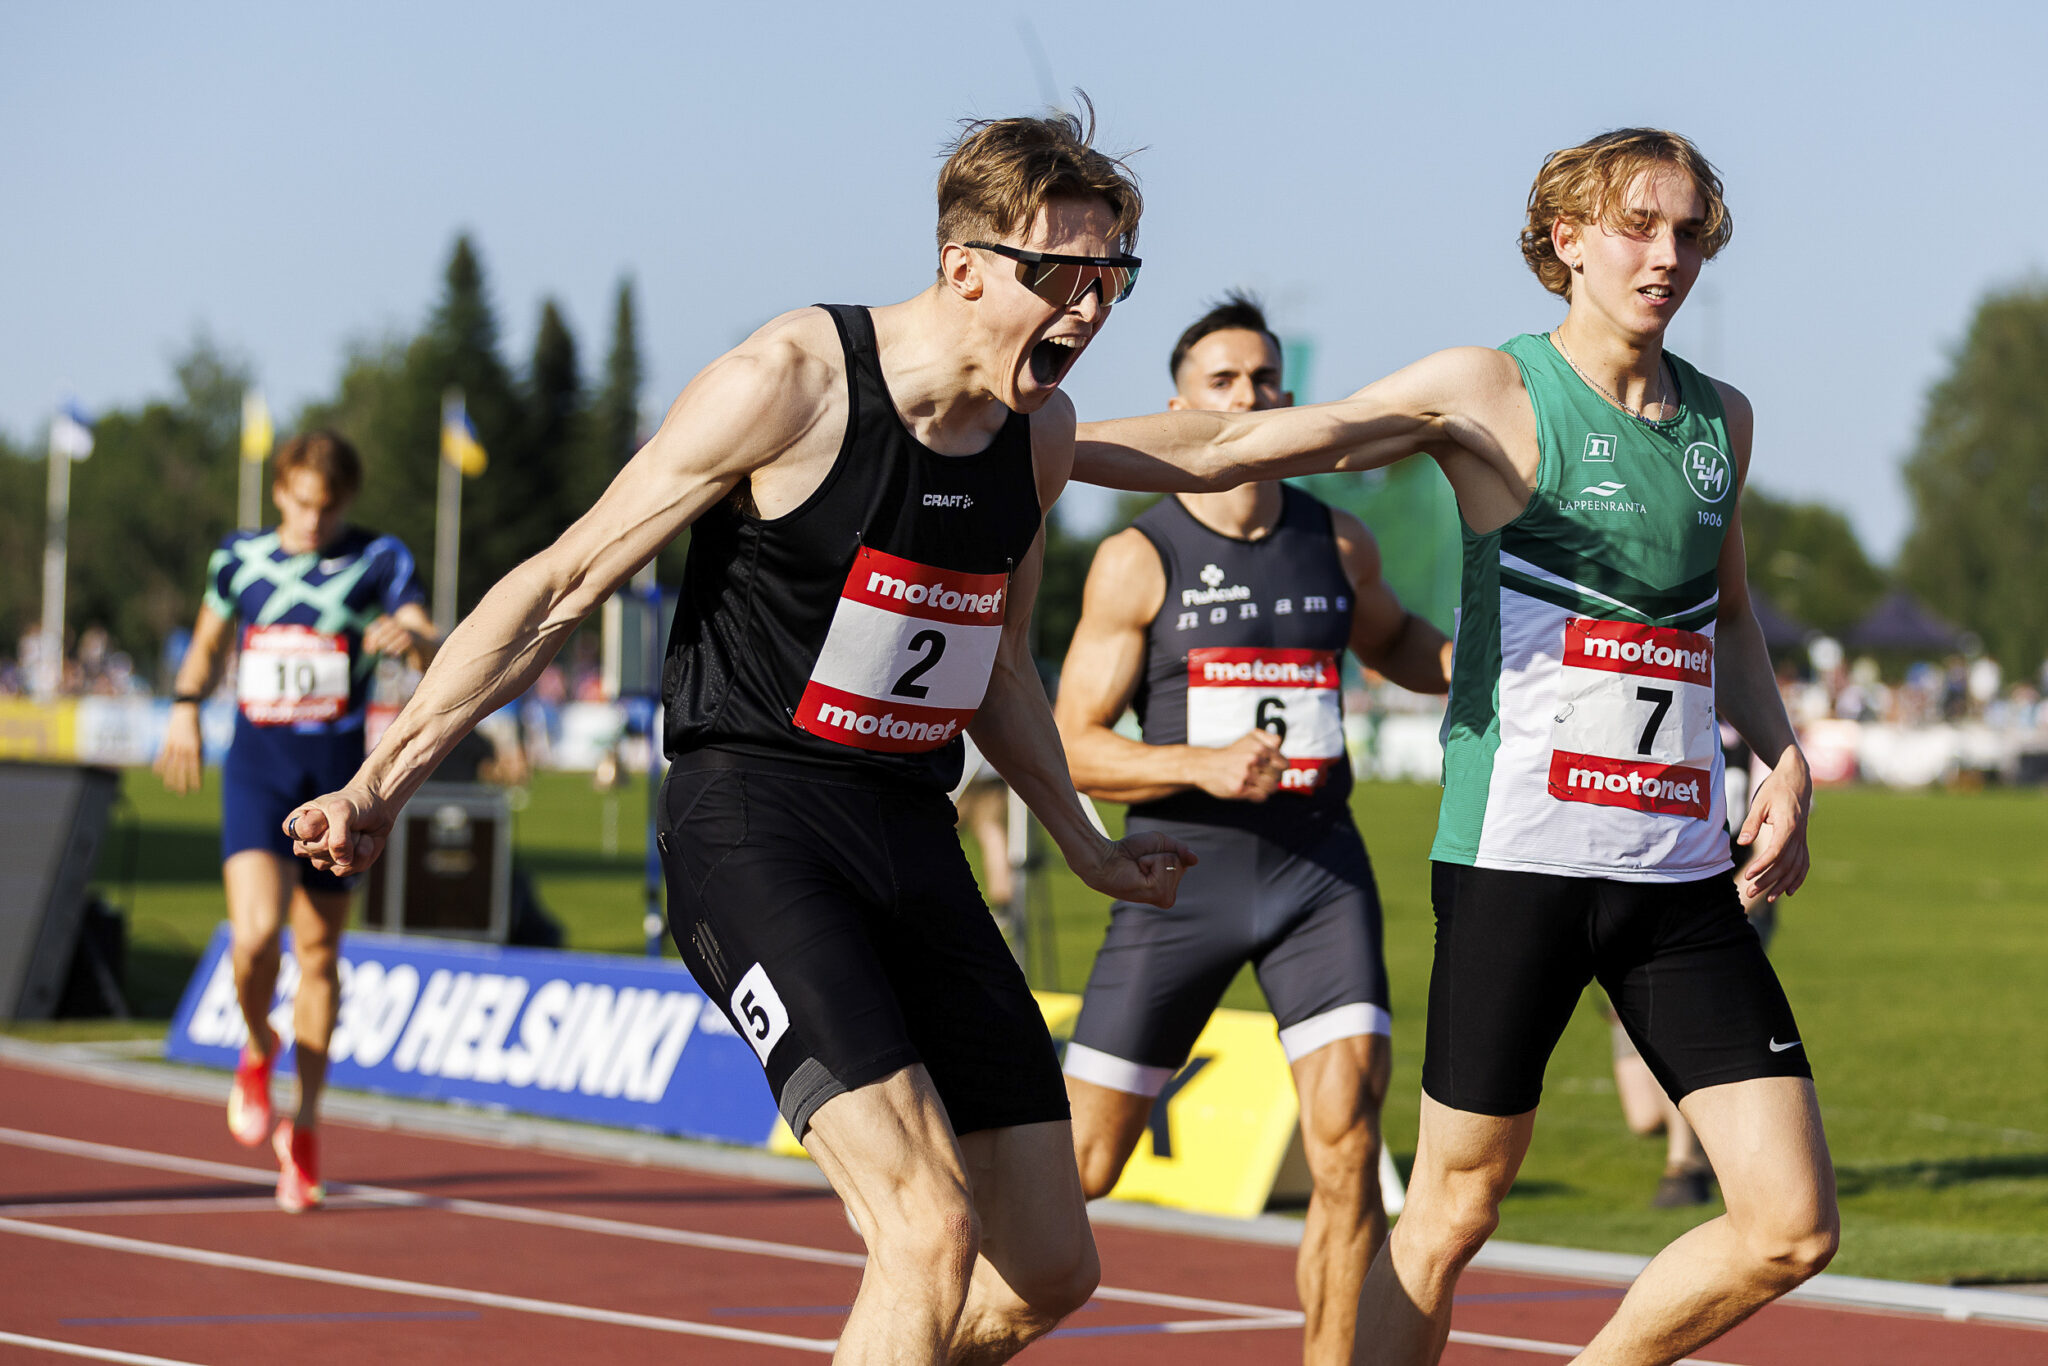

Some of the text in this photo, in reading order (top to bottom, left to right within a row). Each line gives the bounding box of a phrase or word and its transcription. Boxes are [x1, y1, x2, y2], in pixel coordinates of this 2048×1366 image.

[922, 493, 963, 507] CRAFT
[1559, 499, 1648, 514] LAPPEENRANTA
[1697, 510, 1723, 528] 1906
[866, 570, 1002, 614] motonet
[891, 629, 947, 699] 2
[1203, 658, 1327, 684] motonet
[1583, 636, 1708, 673] motonet
[276, 662, 316, 696] 10
[817, 702, 957, 741] motonet
[1255, 696, 1287, 749] 6
[1635, 686, 1674, 755] 7
[1567, 766, 1700, 804] motonet
[740, 988, 770, 1041] 5
[392, 967, 702, 1105] HELSINKI
